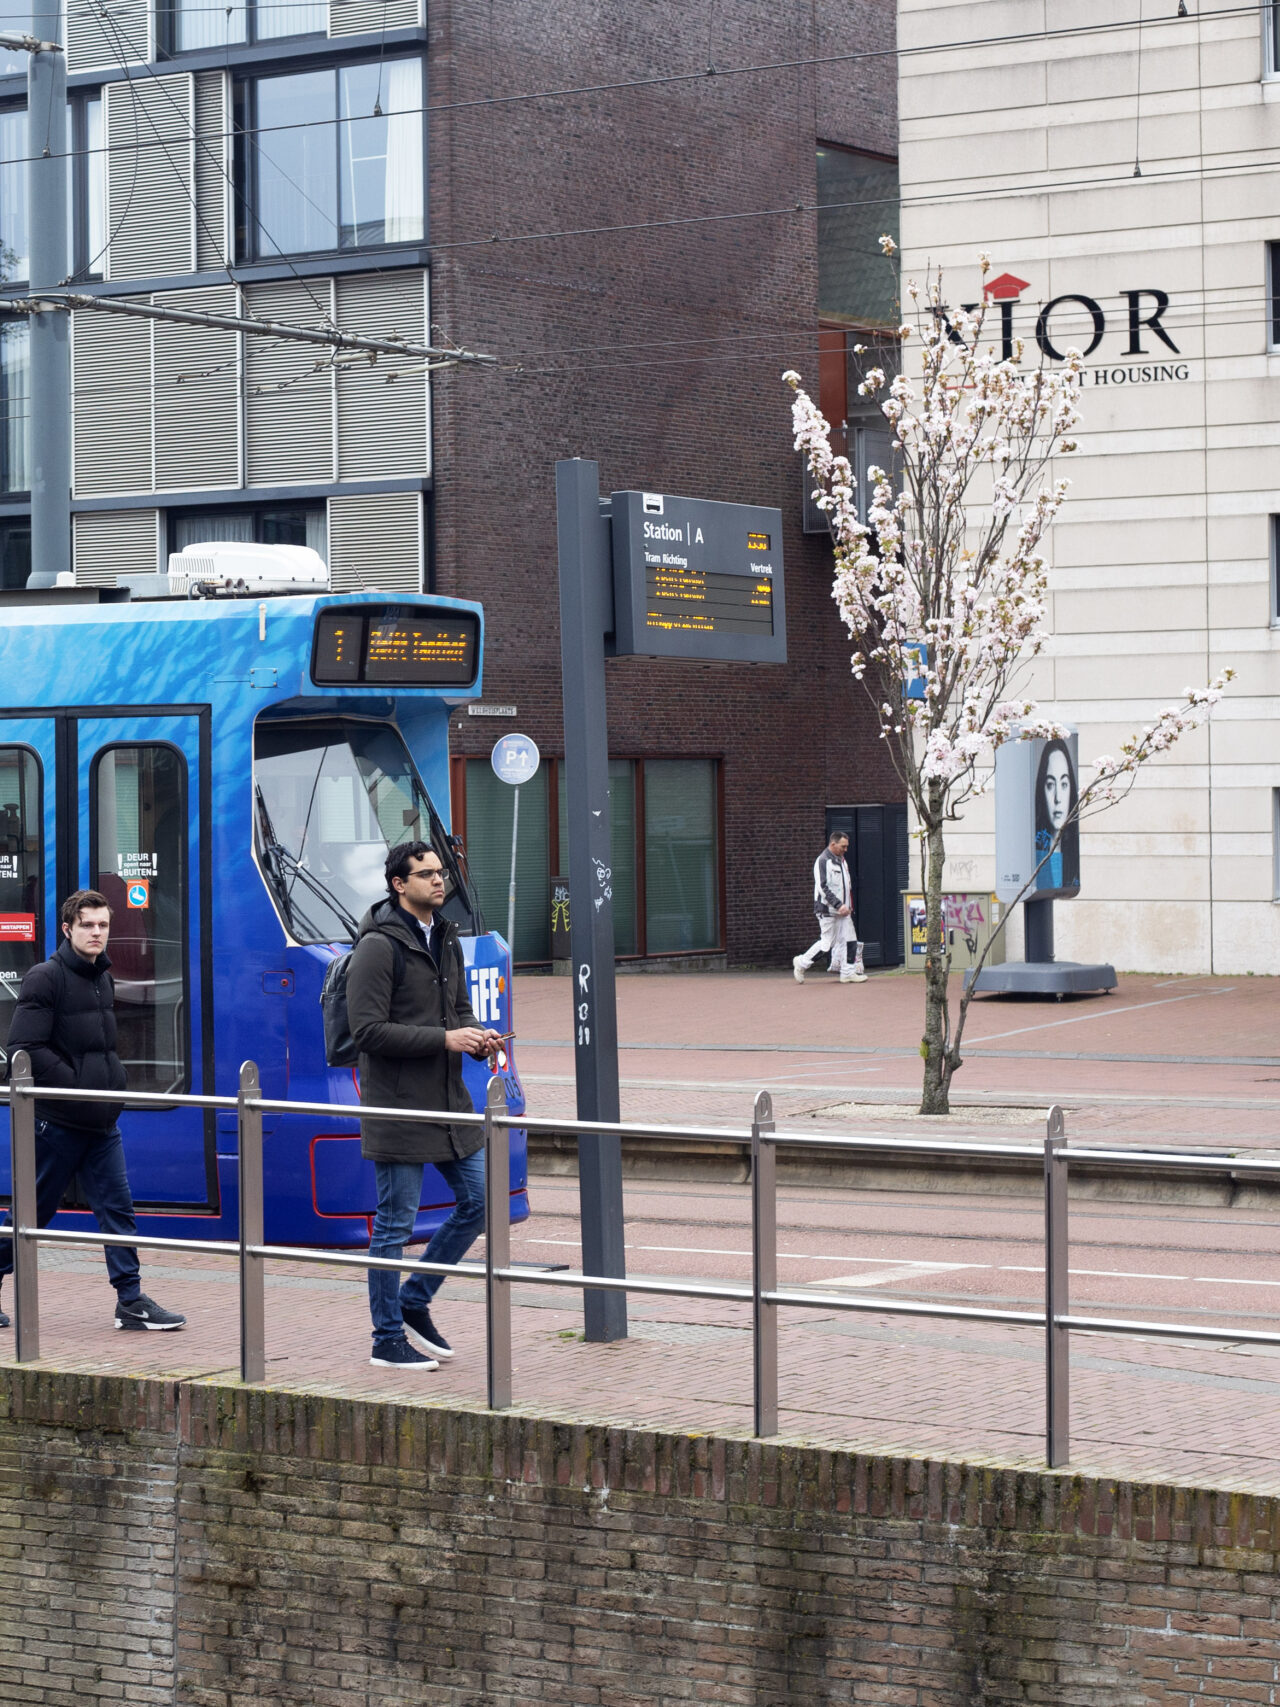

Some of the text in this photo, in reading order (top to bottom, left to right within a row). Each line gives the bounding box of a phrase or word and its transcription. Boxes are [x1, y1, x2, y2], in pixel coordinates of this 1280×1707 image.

[1094, 365, 1190, 385] HOUSING
[643, 521, 704, 544] Station A
[644, 552, 688, 568] Tram Richting
[750, 562, 773, 575] Vertrek
[505, 750, 517, 765] P
[127, 853, 149, 861] DEUR
[123, 869, 152, 877] BUITEN
